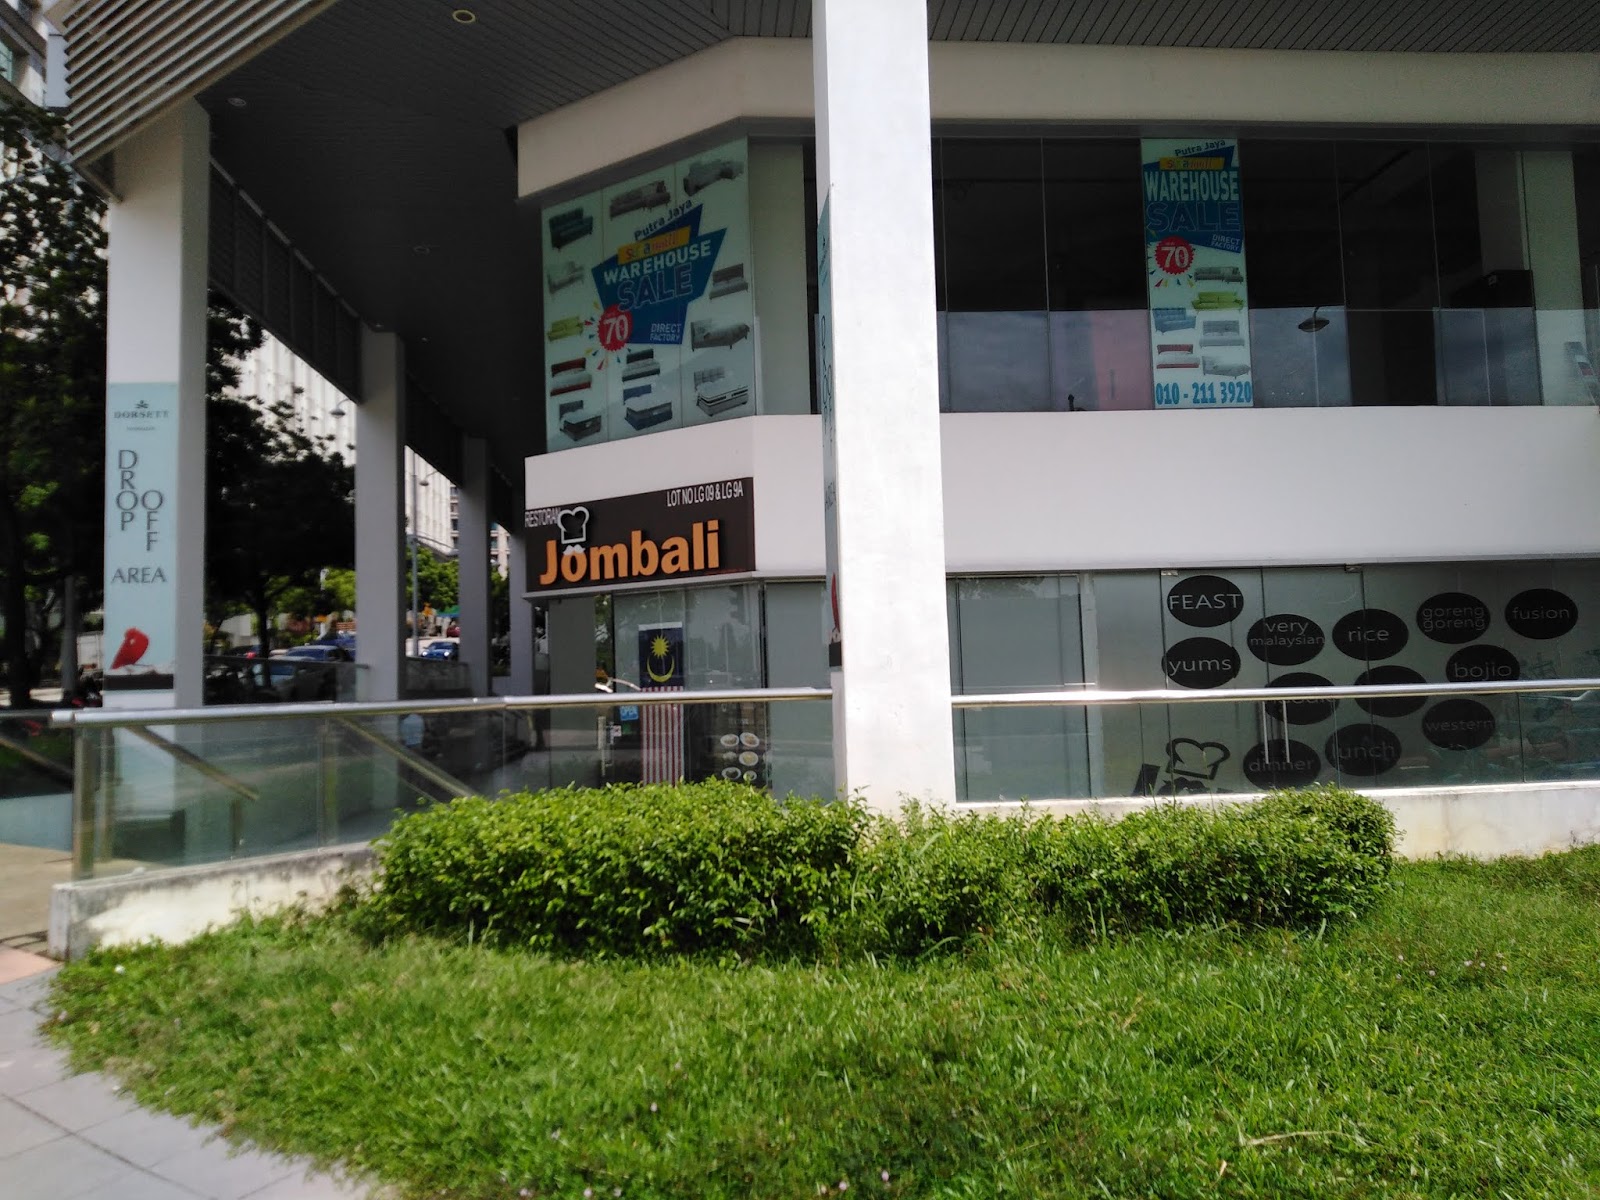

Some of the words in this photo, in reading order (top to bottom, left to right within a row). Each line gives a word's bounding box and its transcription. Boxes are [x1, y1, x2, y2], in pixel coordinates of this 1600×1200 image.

[1174, 146, 1202, 156] Putra
[1204, 140, 1226, 150] Jaya
[1144, 171, 1239, 201] WAREHOUSE
[634, 216, 666, 241] Putra
[668, 200, 692, 223] Jaya
[1146, 201, 1241, 232] SALE
[1211, 240, 1240, 251] FACTORY
[1212, 234, 1240, 245] DIRECT
[604, 239, 712, 286] WAREHOUSE
[1161, 246, 1190, 268] 70
[618, 262, 694, 312] SALE
[603, 314, 629, 344] 70
[650, 322, 682, 334] DIRECT
[649, 333, 681, 342] FACTORY
[1156, 382, 1180, 405] 010
[1192, 382, 1216, 404] 211
[1220, 381, 1252, 404] 3920
[114, 410, 169, 418] DORSETT
[116, 449, 138, 531] DROP
[667, 489, 682, 507] LOT
[682, 487, 694, 504] NO
[694, 486, 704, 503] LG
[705, 484, 714, 502] 09
[715, 484, 721, 500] &
[722, 482, 732, 500] LG
[734, 480, 744, 498] 9A
[142, 489, 164, 551] OFF
[540, 519, 720, 585] Jombali
[111, 567, 166, 584] AREA
[1168, 593, 1242, 610] FEAST
[1422, 605, 1484, 619] goreng
[1512, 606, 1570, 620] fusion
[1264, 622, 1309, 636] very
[1423, 616, 1485, 632] goreng
[1250, 634, 1326, 648] malaysian
[1348, 626, 1390, 642] rice
[1168, 658, 1232, 676] yums
[1454, 661, 1512, 681] bojio
[1426, 719, 1495, 732] western
[1332, 741, 1396, 760] lunch
[1248, 757, 1315, 772] dinner
